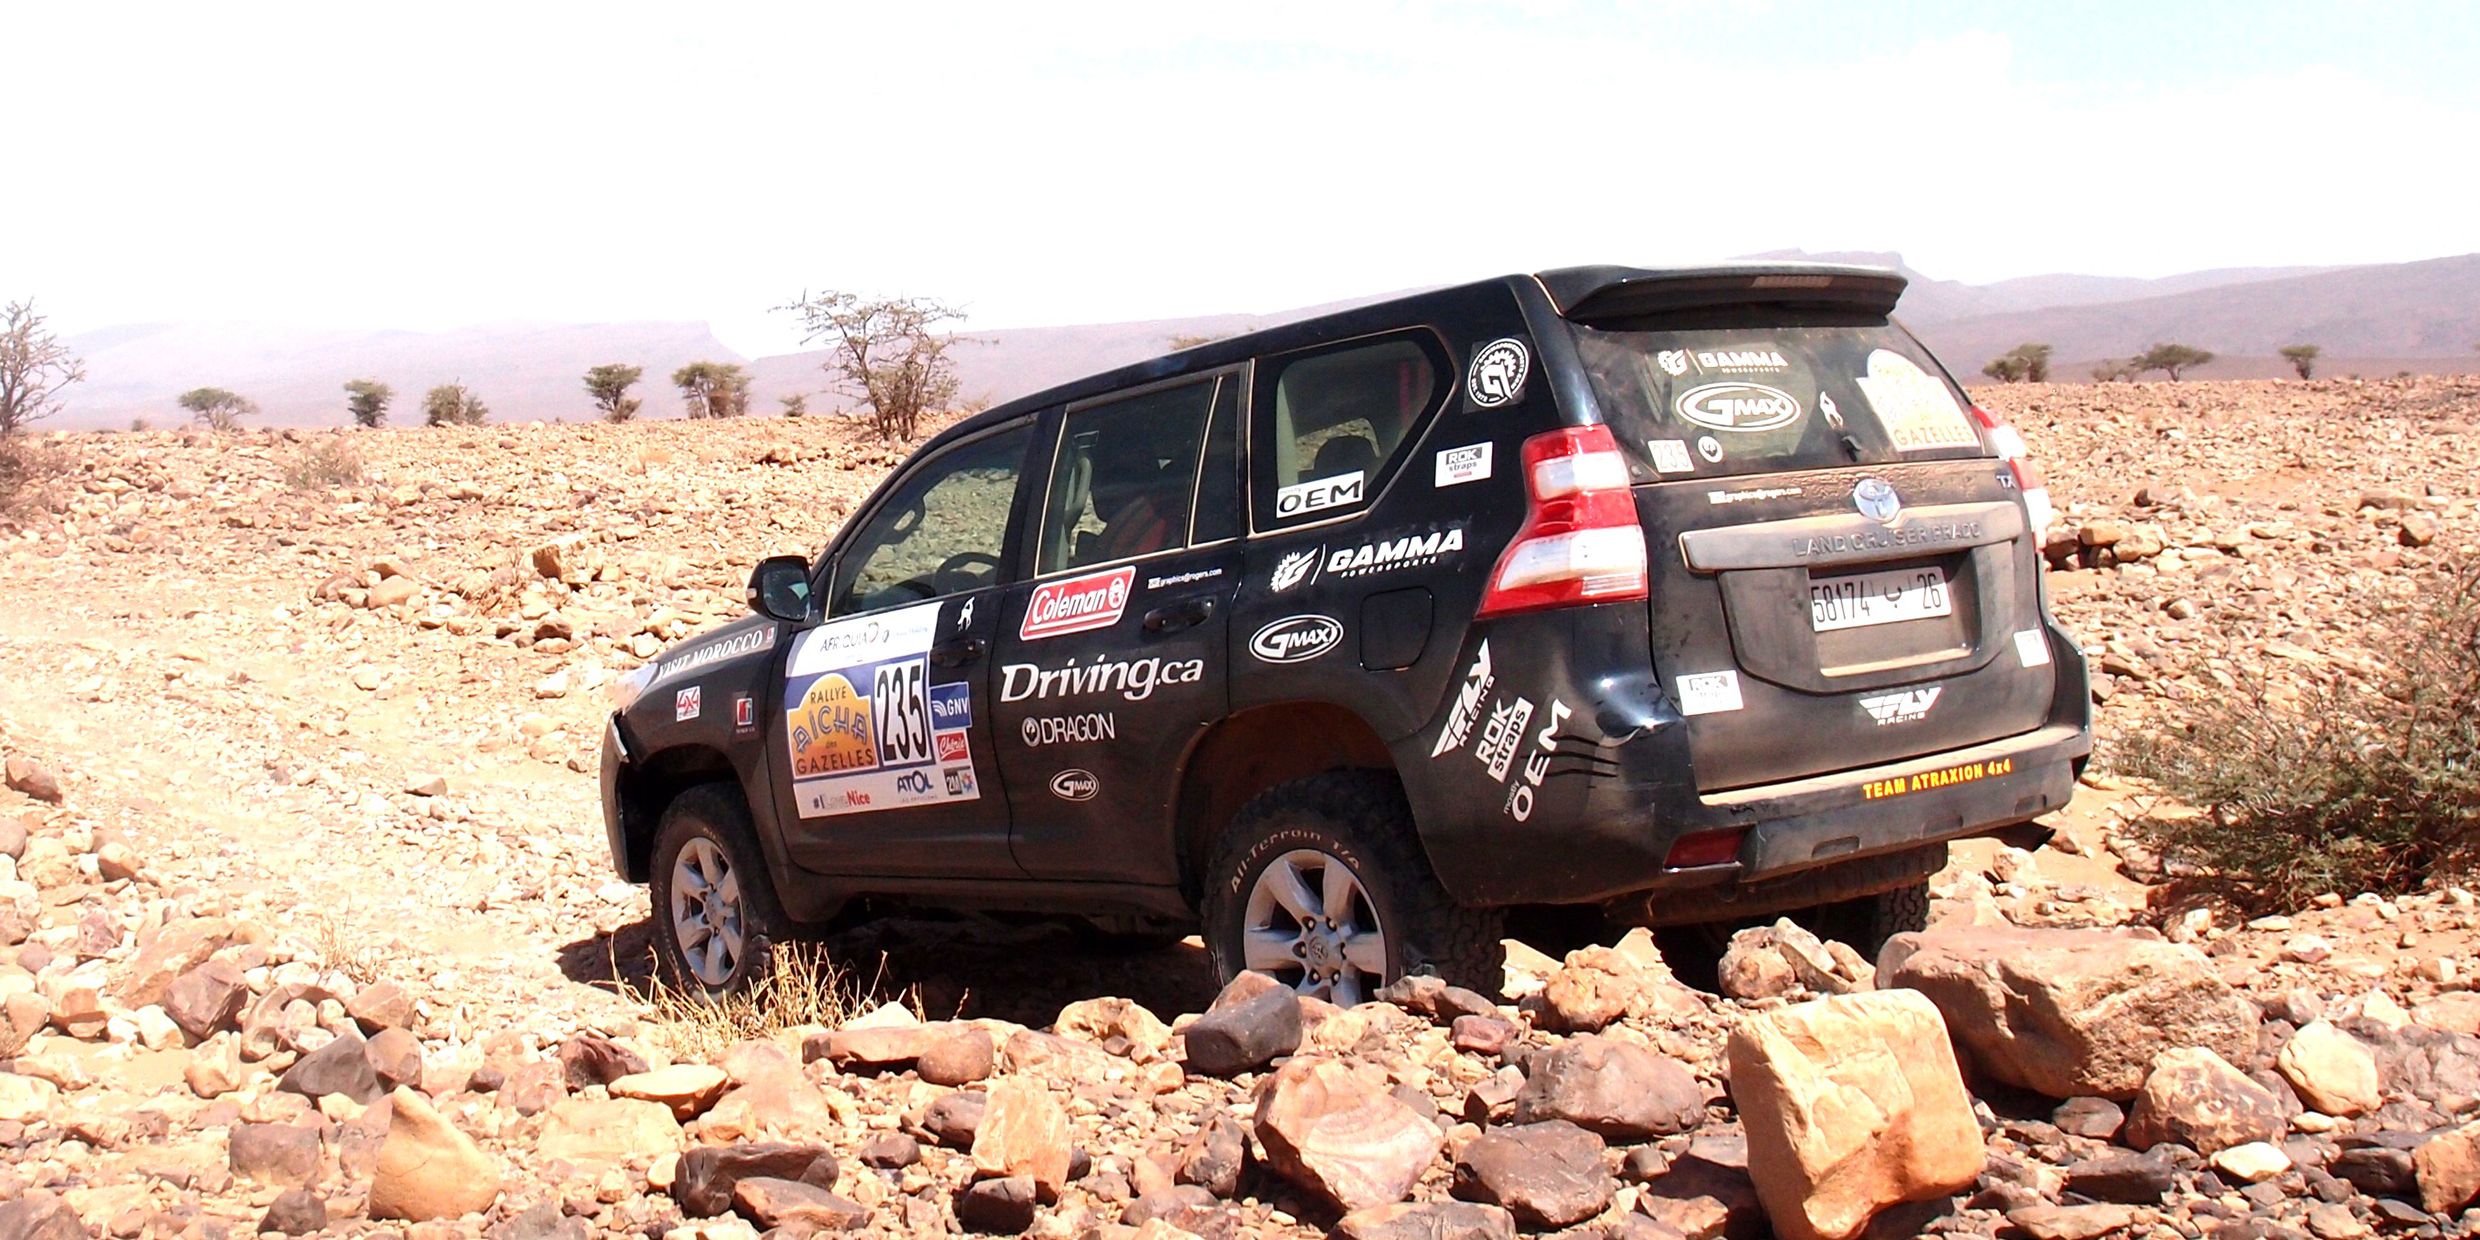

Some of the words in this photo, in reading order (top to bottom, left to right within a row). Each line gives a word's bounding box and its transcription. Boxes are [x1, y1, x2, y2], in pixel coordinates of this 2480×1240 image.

[1698, 351, 1788, 368] GAMMA
[1447, 448, 1480, 464] ROK
[1449, 461, 1477, 472] straps
[1279, 480, 1361, 512] OEM
[1327, 529, 1463, 573] GAMMA
[1793, 535, 1846, 557] LAND
[1850, 530, 1927, 550] CRUISER
[1931, 522, 1980, 543] PRADO
[1032, 587, 1104, 625] Coleman
[1811, 579, 1870, 623] 58174
[1917, 573, 1942, 610] 26
[659, 654, 692, 679] VISIT
[690, 629, 763, 664] MOROCCO
[1253, 619, 1339, 658] GMAX
[810, 685, 847, 705] RALLYE
[1001, 653, 1204, 703] Driving.ca
[877, 664, 927, 761] 235
[946, 696, 968, 716] GNV
[1859, 687, 1941, 719] FLY
[1877, 712, 1926, 726] RACING
[1040, 712, 1116, 744] DRAGON
[1476, 698, 1515, 765] ROK
[1493, 709, 1526, 773] straps
[796, 748, 873, 775] GAZELLES
[1512, 698, 1573, 823] OEM
[1863, 777, 1906, 799] TEAM
[1911, 763, 1983, 791] ATRAXION
[1987, 758, 2011, 775] 4x4
[897, 770, 934, 793] ATOL
[1503, 779, 1520, 815] mostly
[1231, 829, 1321, 894] All-Terrain
